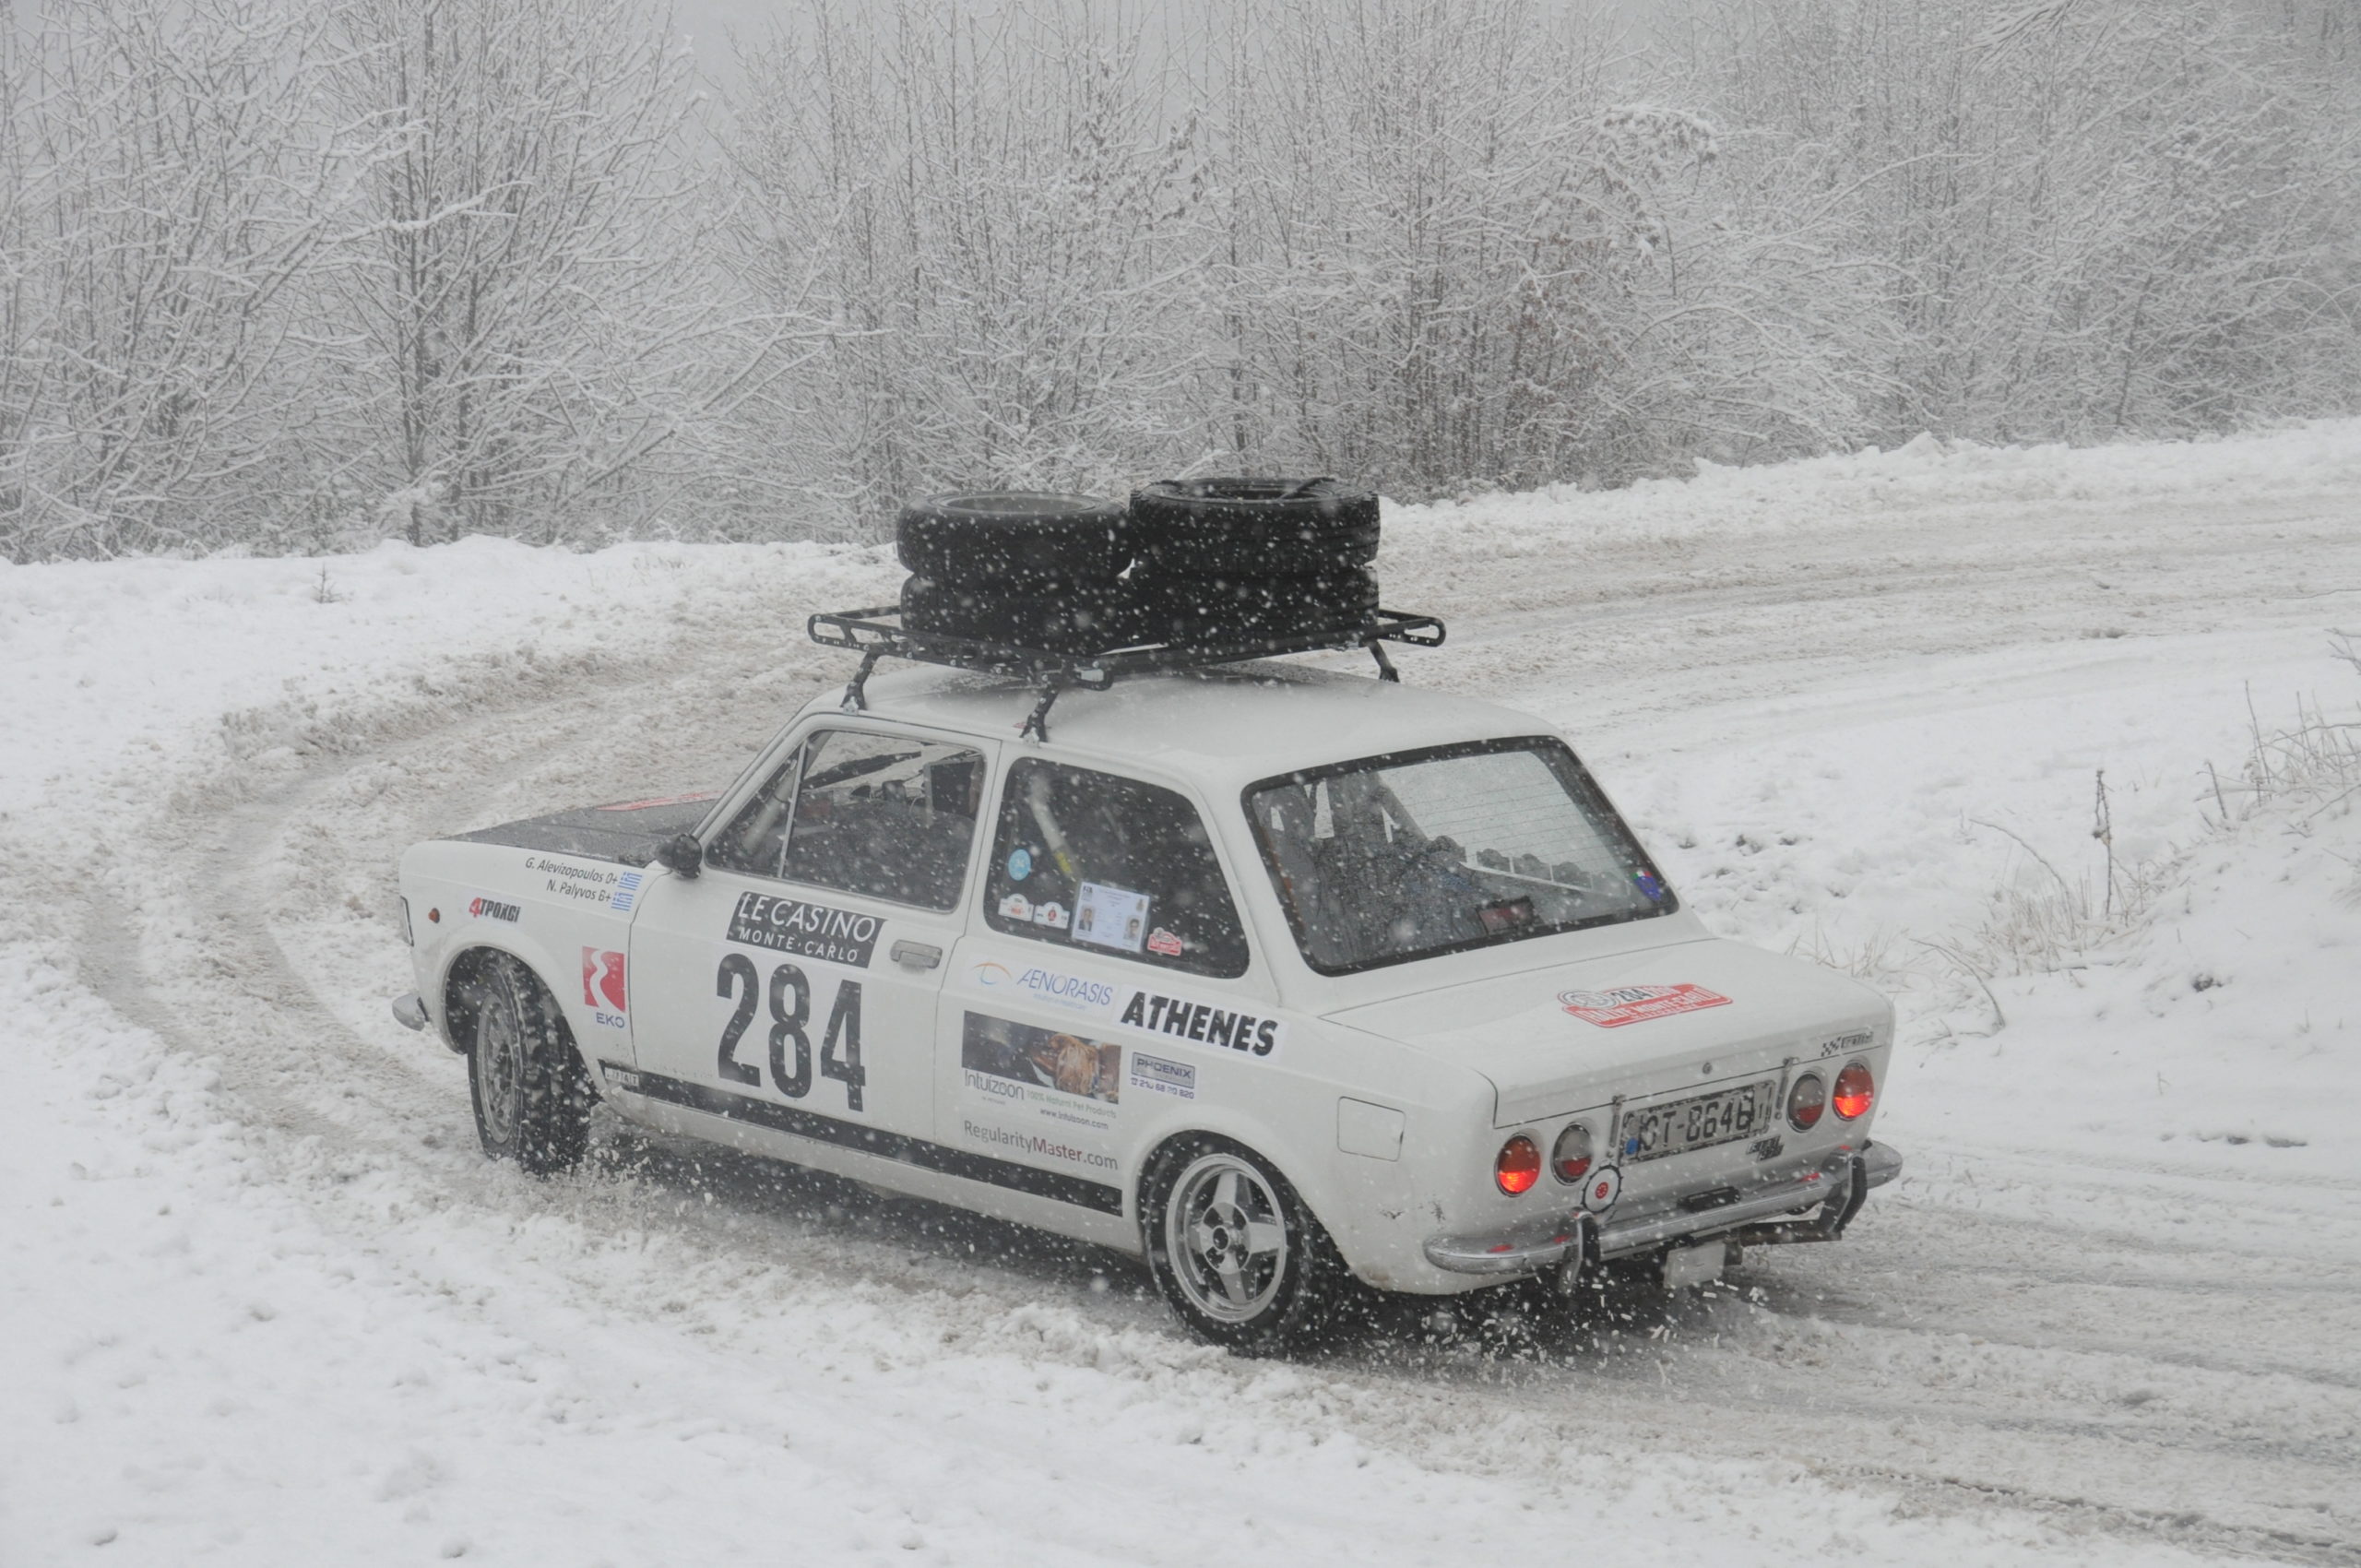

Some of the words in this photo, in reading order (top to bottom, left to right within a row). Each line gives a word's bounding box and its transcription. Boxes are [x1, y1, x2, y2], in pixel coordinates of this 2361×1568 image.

[525, 857, 535, 869] G.
[537, 860, 604, 883] Alevizopoulos
[547, 879, 557, 892] N.
[559, 882, 597, 900] Palyvos
[738, 892, 770, 921] LE
[771, 899, 876, 943] CASINO
[739, 926, 795, 951] MONTE
[804, 941, 858, 963] CARLO
[596, 1012, 625, 1029] EKO
[716, 953, 866, 1112] 284
[1120, 991, 1279, 1057] ATHENES
[1136, 1058, 1192, 1079] PHOENIX
[1086, 1104, 1117, 1119] Products
[964, 1120, 1119, 1170] RegularityMaster.com
